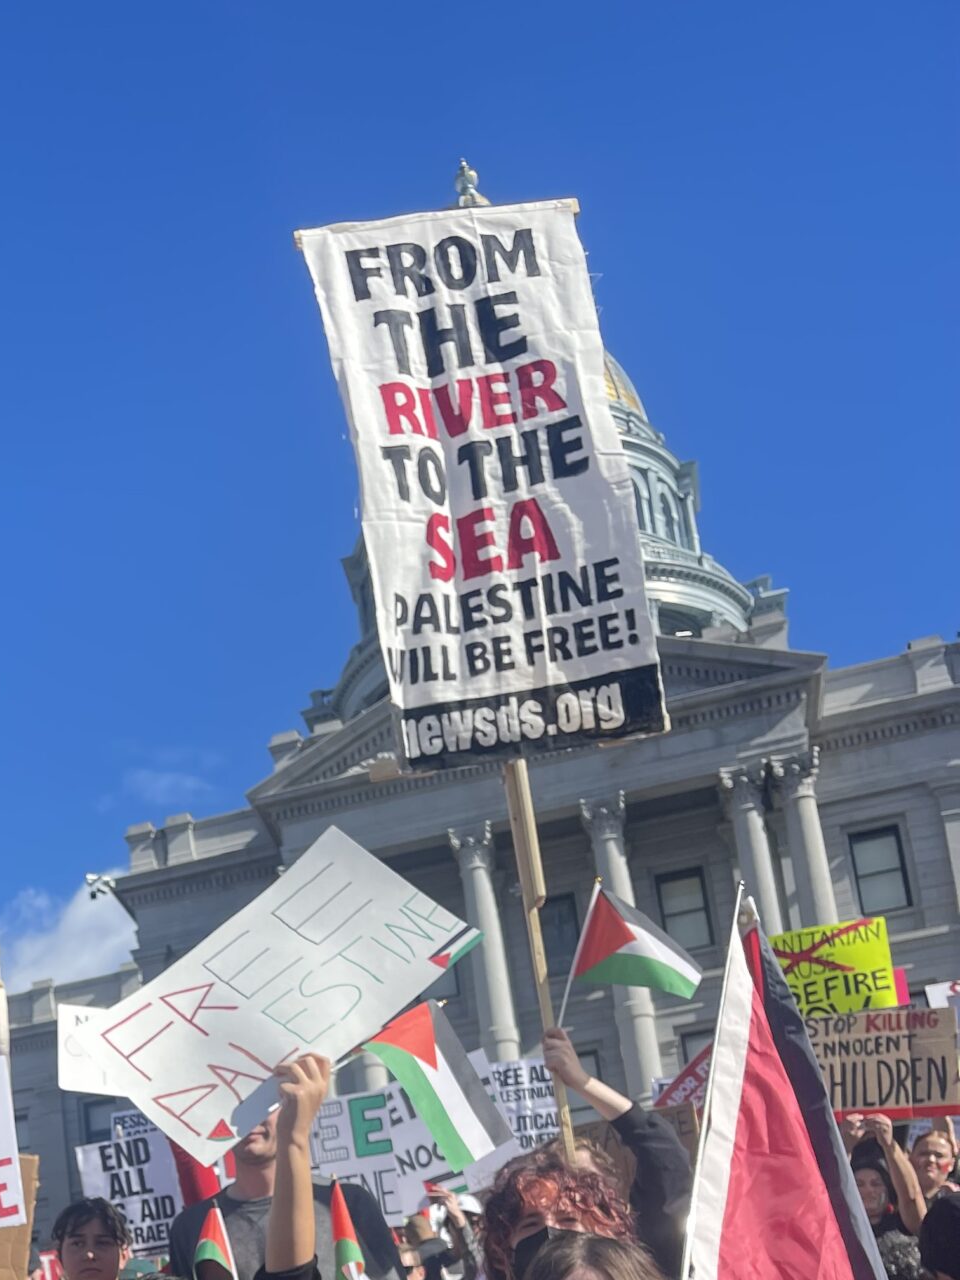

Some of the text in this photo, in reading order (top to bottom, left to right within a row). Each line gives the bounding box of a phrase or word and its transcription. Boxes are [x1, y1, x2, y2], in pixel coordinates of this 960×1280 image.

[345, 228, 541, 301] FROM
[373, 291, 527, 378] THE
[379, 359, 567, 439] RIVER
[380, 414, 590, 506] TO THE
[425, 498, 560, 582] SEA
[394, 557, 624, 636] PALESTINE
[465, 635, 516, 677] BE
[523, 608, 639, 667] FREE!
[401, 681, 626, 759] newsds.org
[101, 862, 373, 1082] FREE
[153, 891, 462, 1137] PALESTINE
[806, 1010, 939, 1038] STOP KILLING
[821, 1056, 948, 1107] HILDREN
[98, 1138, 150, 1172] END
[110, 1168, 154, 1200] ALL
[141, 1195, 176, 1223] AID
